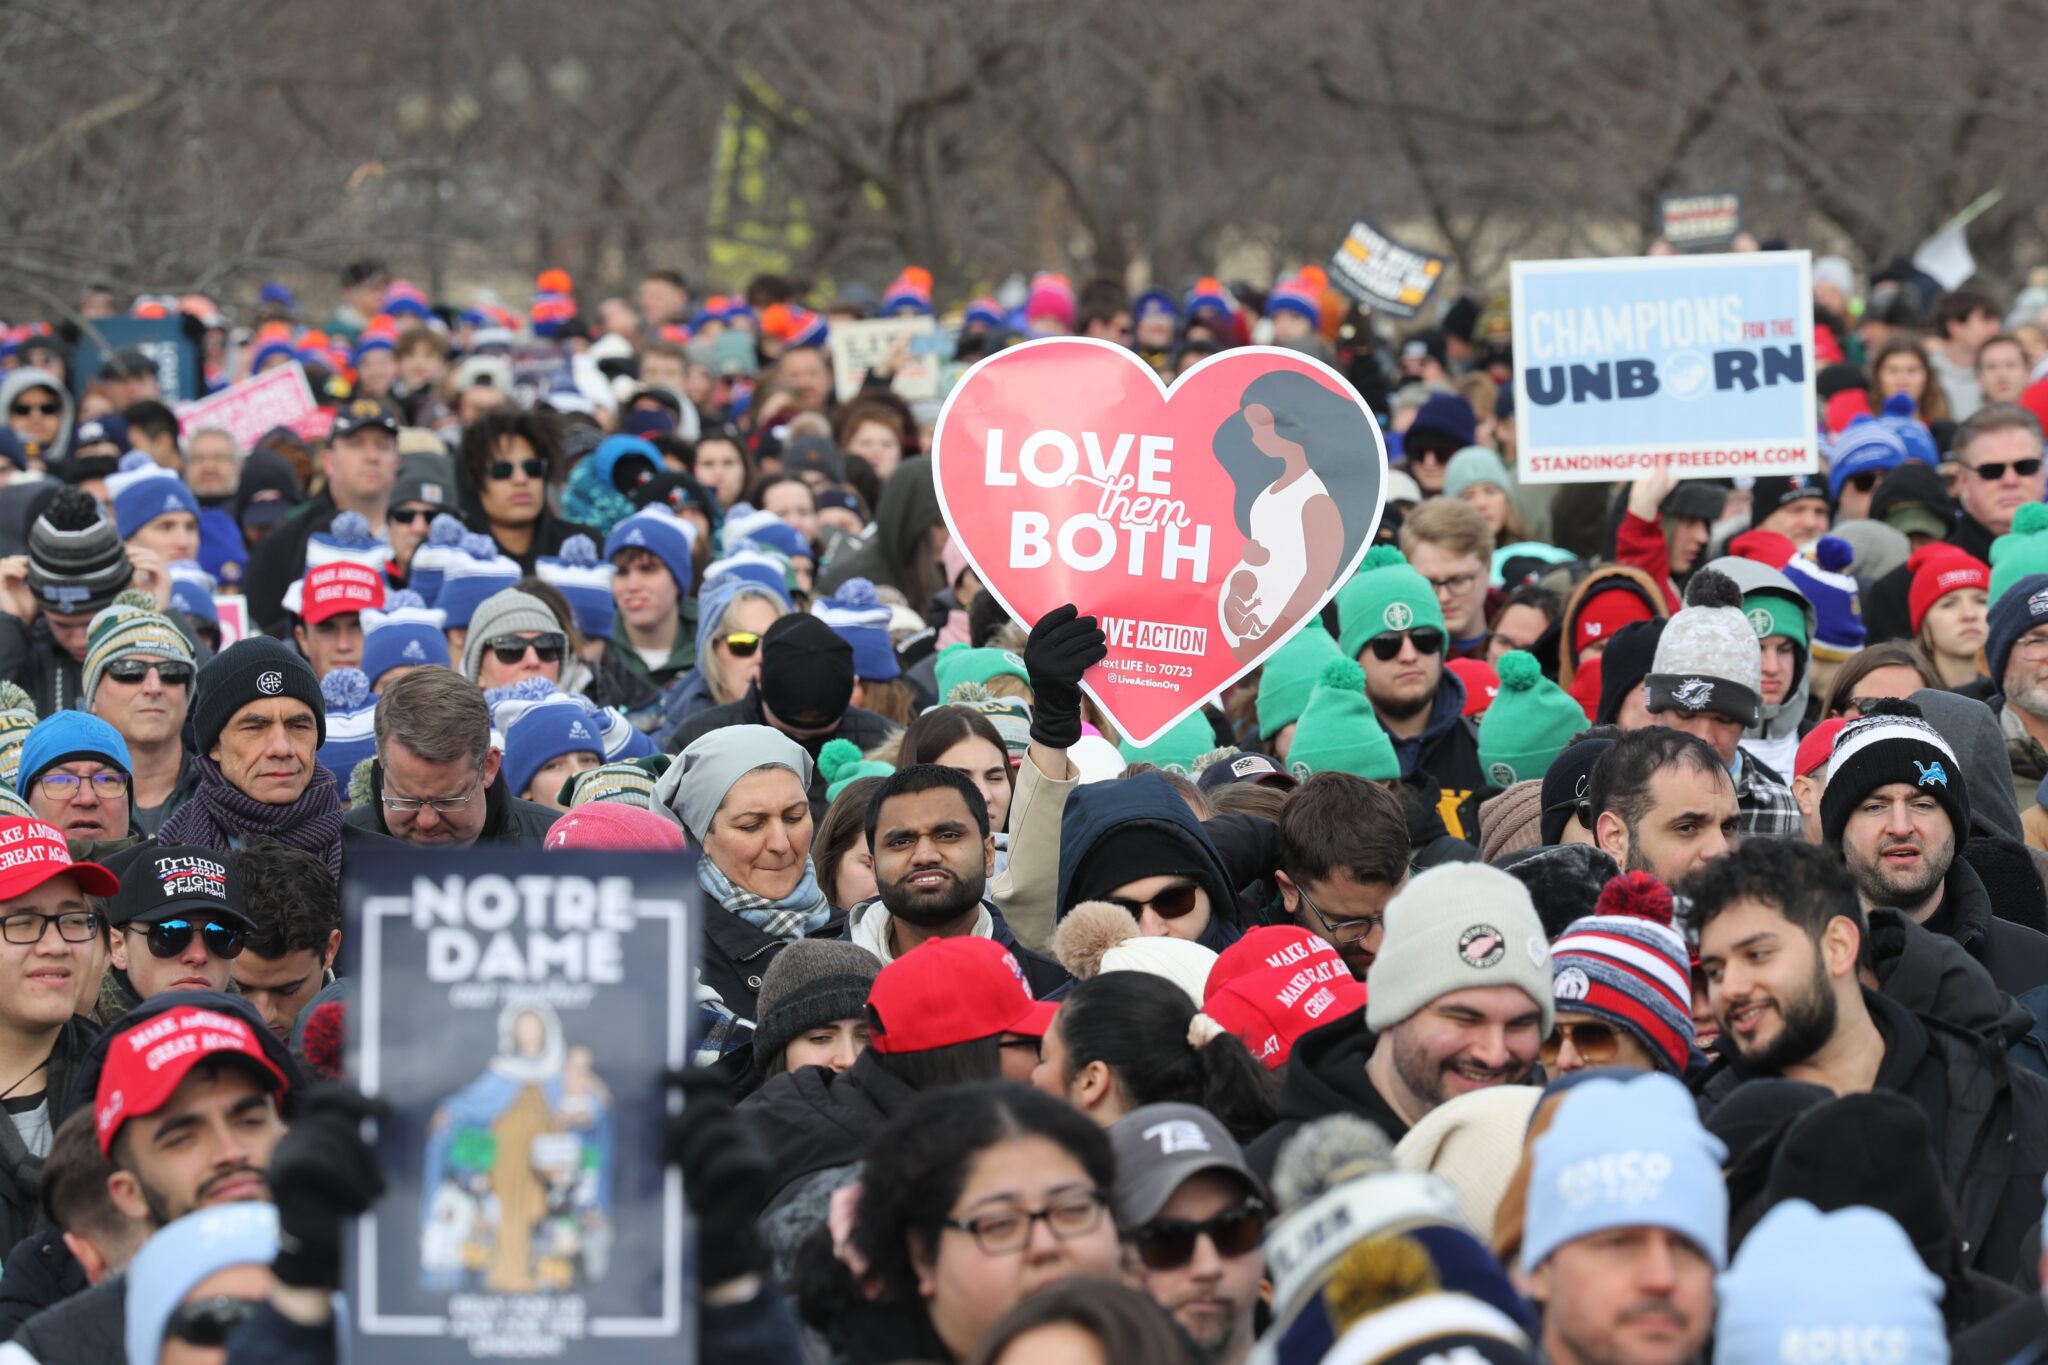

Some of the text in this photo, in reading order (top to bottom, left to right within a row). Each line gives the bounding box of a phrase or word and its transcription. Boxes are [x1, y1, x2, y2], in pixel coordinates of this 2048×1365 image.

[1530, 295, 1795, 358] CHAMPIONS FOR THE
[985, 428, 1174, 495] LOVE
[1066, 473, 1191, 528] them
[1010, 511, 1211, 583] BOTH
[1093, 615, 1205, 653] IVE ACTION
[1121, 659, 1143, 672] LIFE
[1145, 663, 1156, 673] to
[1159, 664, 1193, 677] 70723
[155, 856, 225, 876] Trump
[191, 867, 217, 879] 2024
[412, 873, 636, 932] NOTRE
[427, 926, 624, 983] DAME
[1265, 942, 1309, 968] MAKE
[1276, 972, 1312, 1008] MAKE
[129, 1016, 179, 1053] MAKE
[146, 1033, 198, 1071] GREAT
